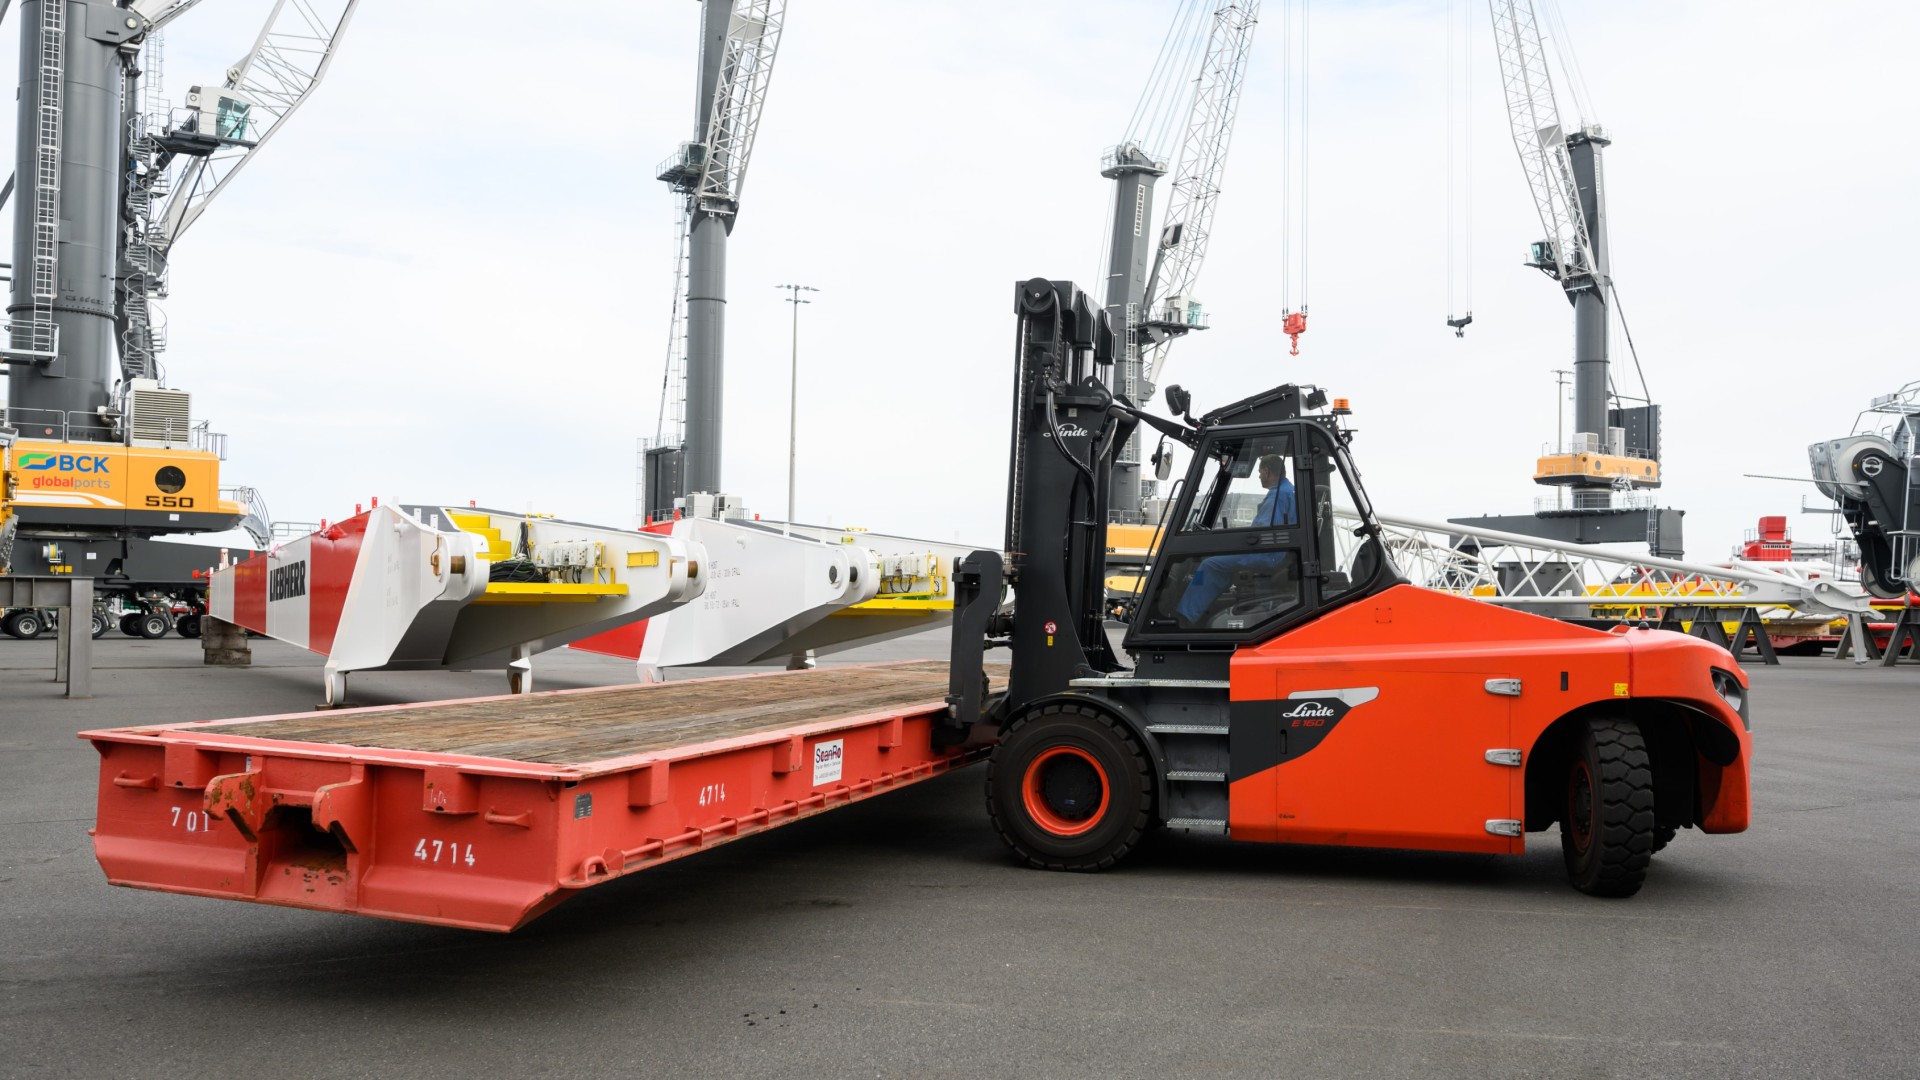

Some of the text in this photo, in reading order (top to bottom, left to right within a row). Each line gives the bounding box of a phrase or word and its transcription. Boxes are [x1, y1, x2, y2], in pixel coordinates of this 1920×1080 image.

[59, 454, 110, 474] BCK
[33, 475, 111, 490] globalports
[145, 495, 194, 508] 550
[270, 559, 306, 602] LIEBHERR
[1282, 701, 1335, 718] Linde
[1291, 719, 1325, 727] E 160
[699, 783, 726, 807] 4714
[414, 838, 476, 867] 4714
